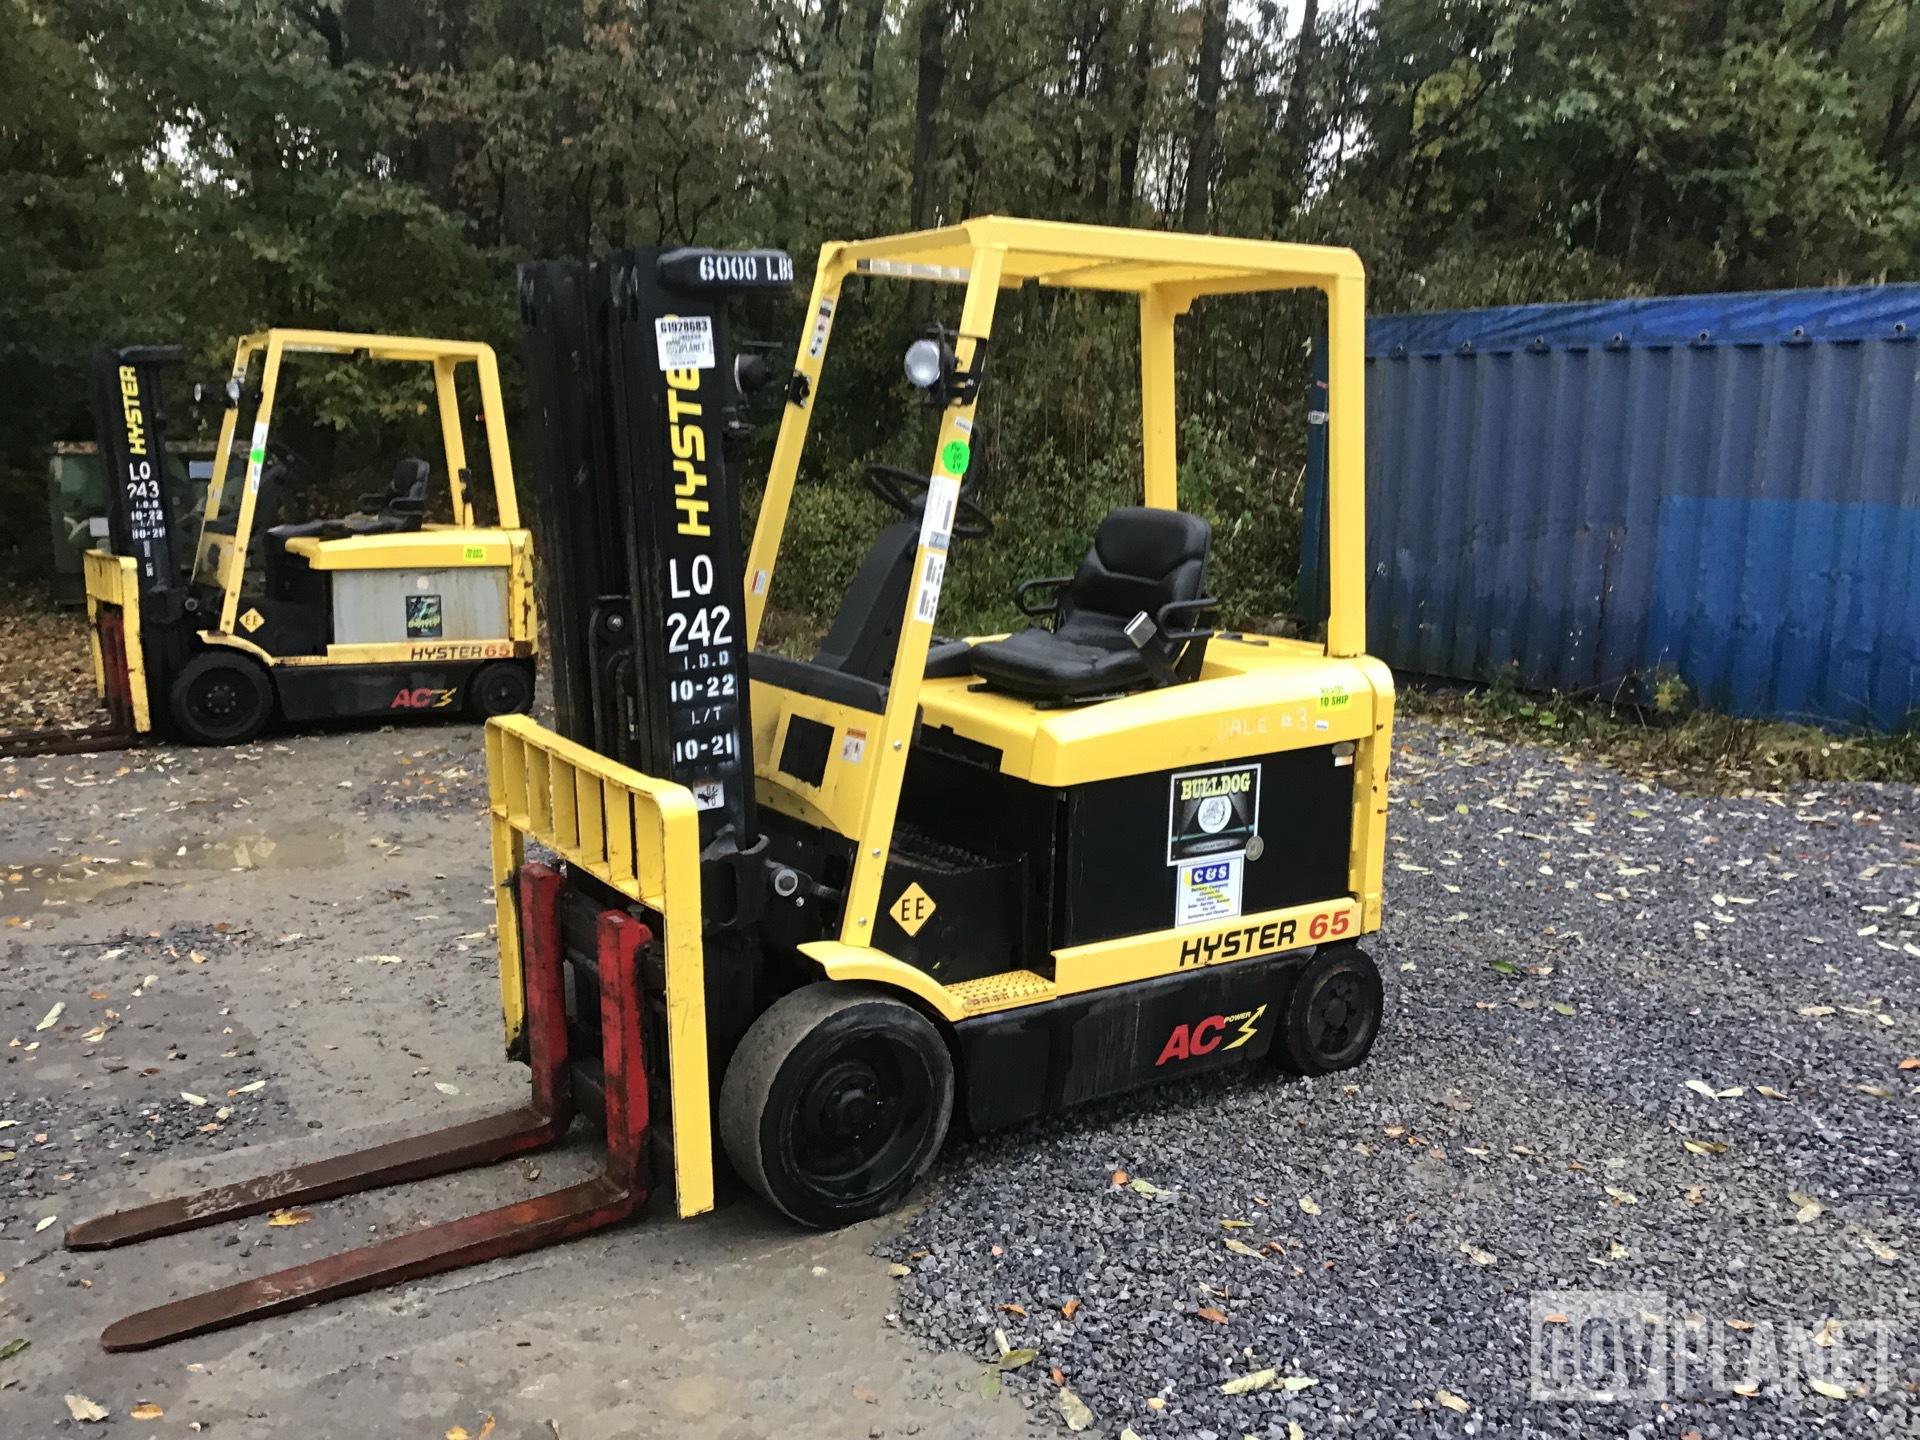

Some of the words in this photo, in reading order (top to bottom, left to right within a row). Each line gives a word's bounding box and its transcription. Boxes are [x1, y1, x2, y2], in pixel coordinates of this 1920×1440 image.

[700, 256, 757, 280] 6000
[119, 365, 147, 455] HYSTER
[662, 314, 711, 537] HYSTE
[129, 461, 151, 480] LO
[666, 604, 732, 653] 242
[411, 646, 482, 661] HYSTER
[484, 645, 510, 658] 65
[390, 687, 433, 708] AC
[671, 673, 735, 702] 10-22
[1320, 697, 1329, 707] TO
[1331, 695, 1349, 706] SHIP
[691, 706, 722, 725] L/T
[676, 732, 732, 762] 10-21
[1181, 772, 1251, 801] BULLDOG
[1193, 869, 1204, 883] C
[1205, 868, 1217, 881] &
[1218, 865, 1228, 879] S
[901, 897, 926, 922] EE
[1179, 919, 1297, 967] HYSTER
[1309, 909, 1351, 940] 65
[1155, 1015, 1226, 1067] AC
[1223, 1011, 1252, 1024] POWER
